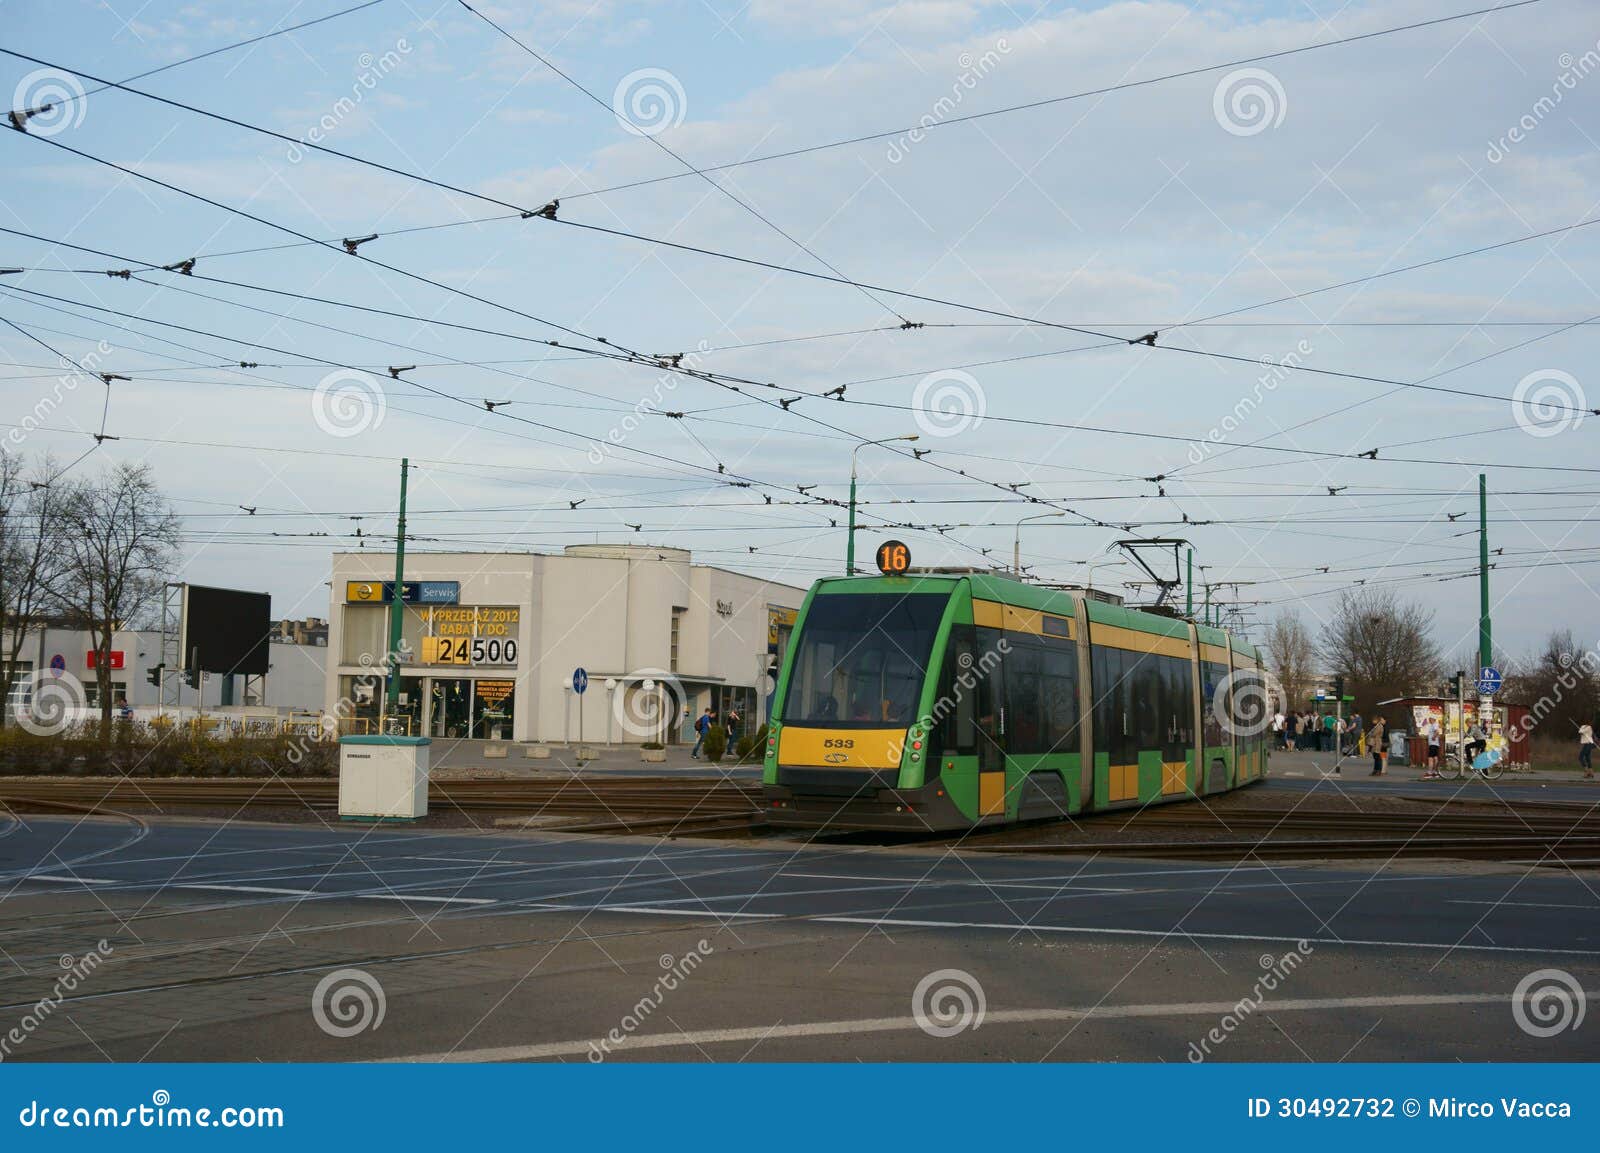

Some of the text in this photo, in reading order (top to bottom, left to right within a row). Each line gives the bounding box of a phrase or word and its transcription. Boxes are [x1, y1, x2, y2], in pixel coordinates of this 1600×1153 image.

[881, 545, 907, 571] 16
[493, 610, 518, 622] 2012
[440, 623, 485, 635] RABATY
[823, 739, 854, 748] 533
